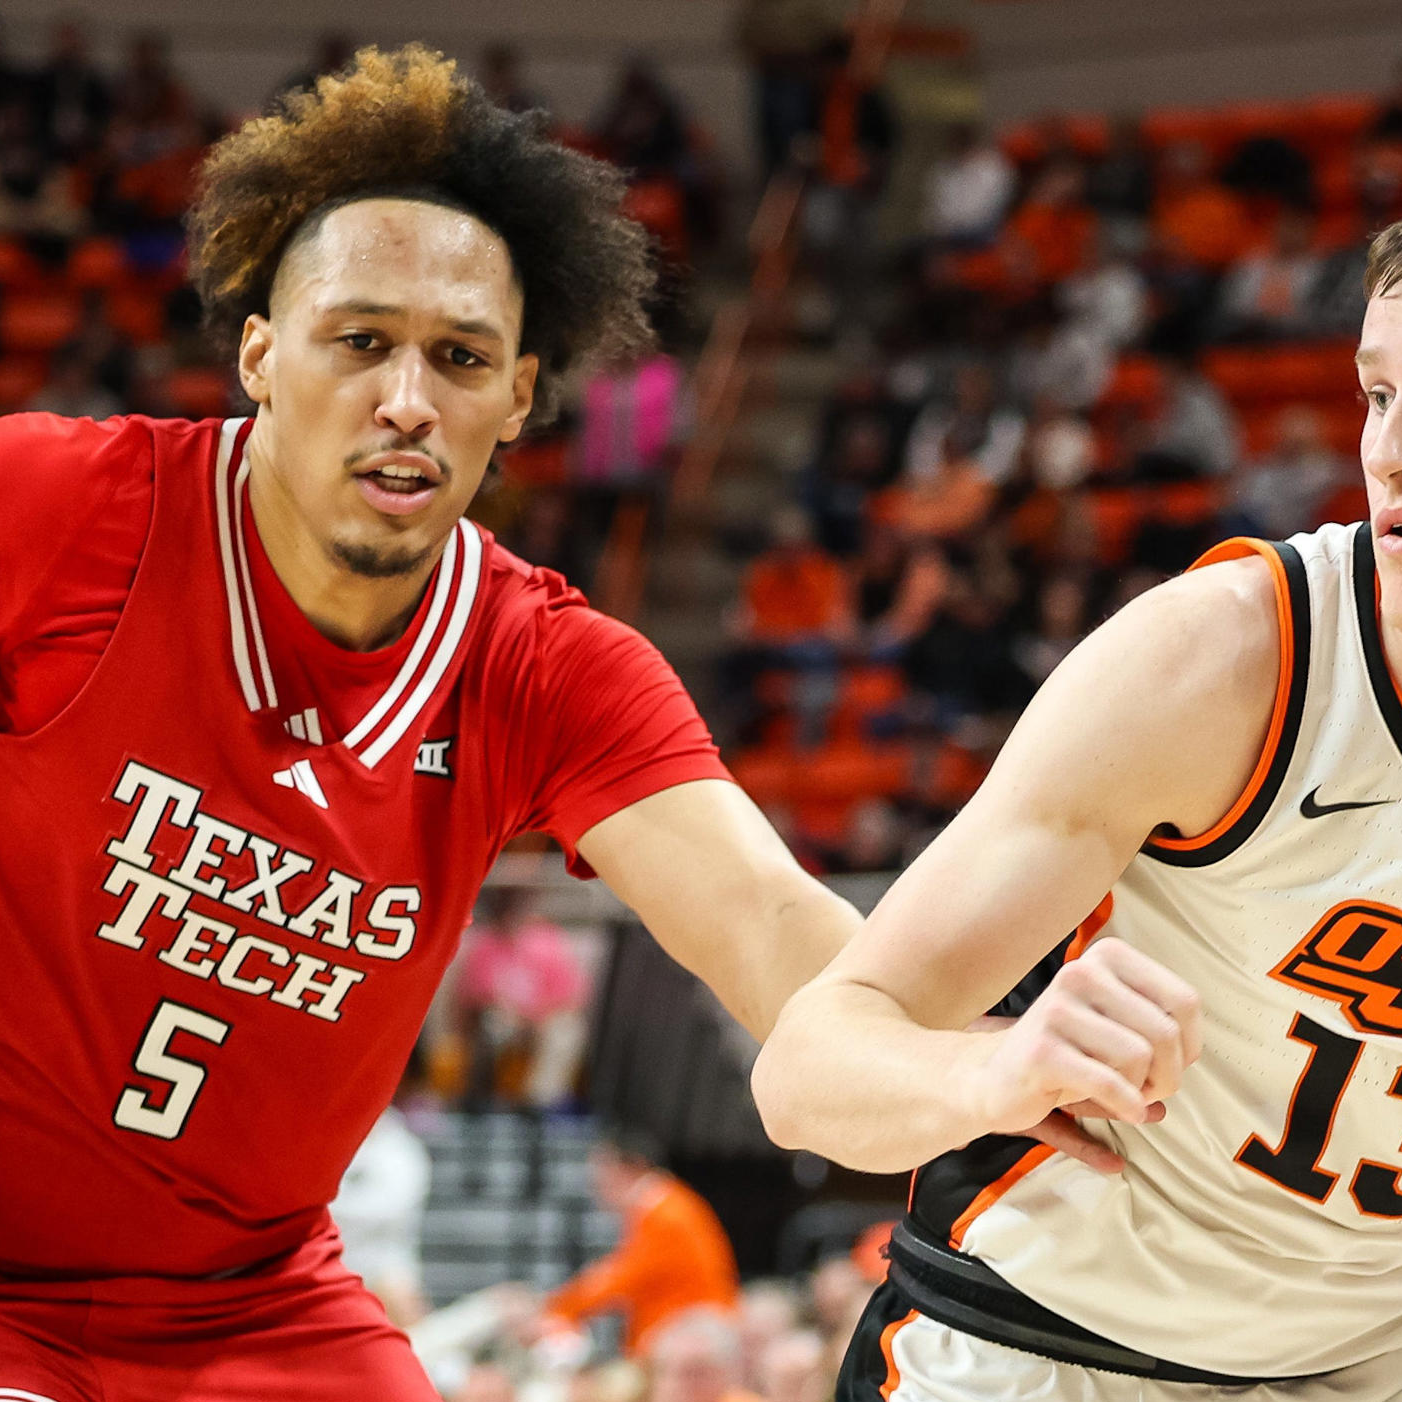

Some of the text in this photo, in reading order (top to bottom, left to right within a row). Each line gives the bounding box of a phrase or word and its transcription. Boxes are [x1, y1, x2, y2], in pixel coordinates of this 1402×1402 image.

[107, 760, 421, 960] TEXAS
[98, 861, 366, 1022] TECH
[113, 997, 233, 1140] 5
